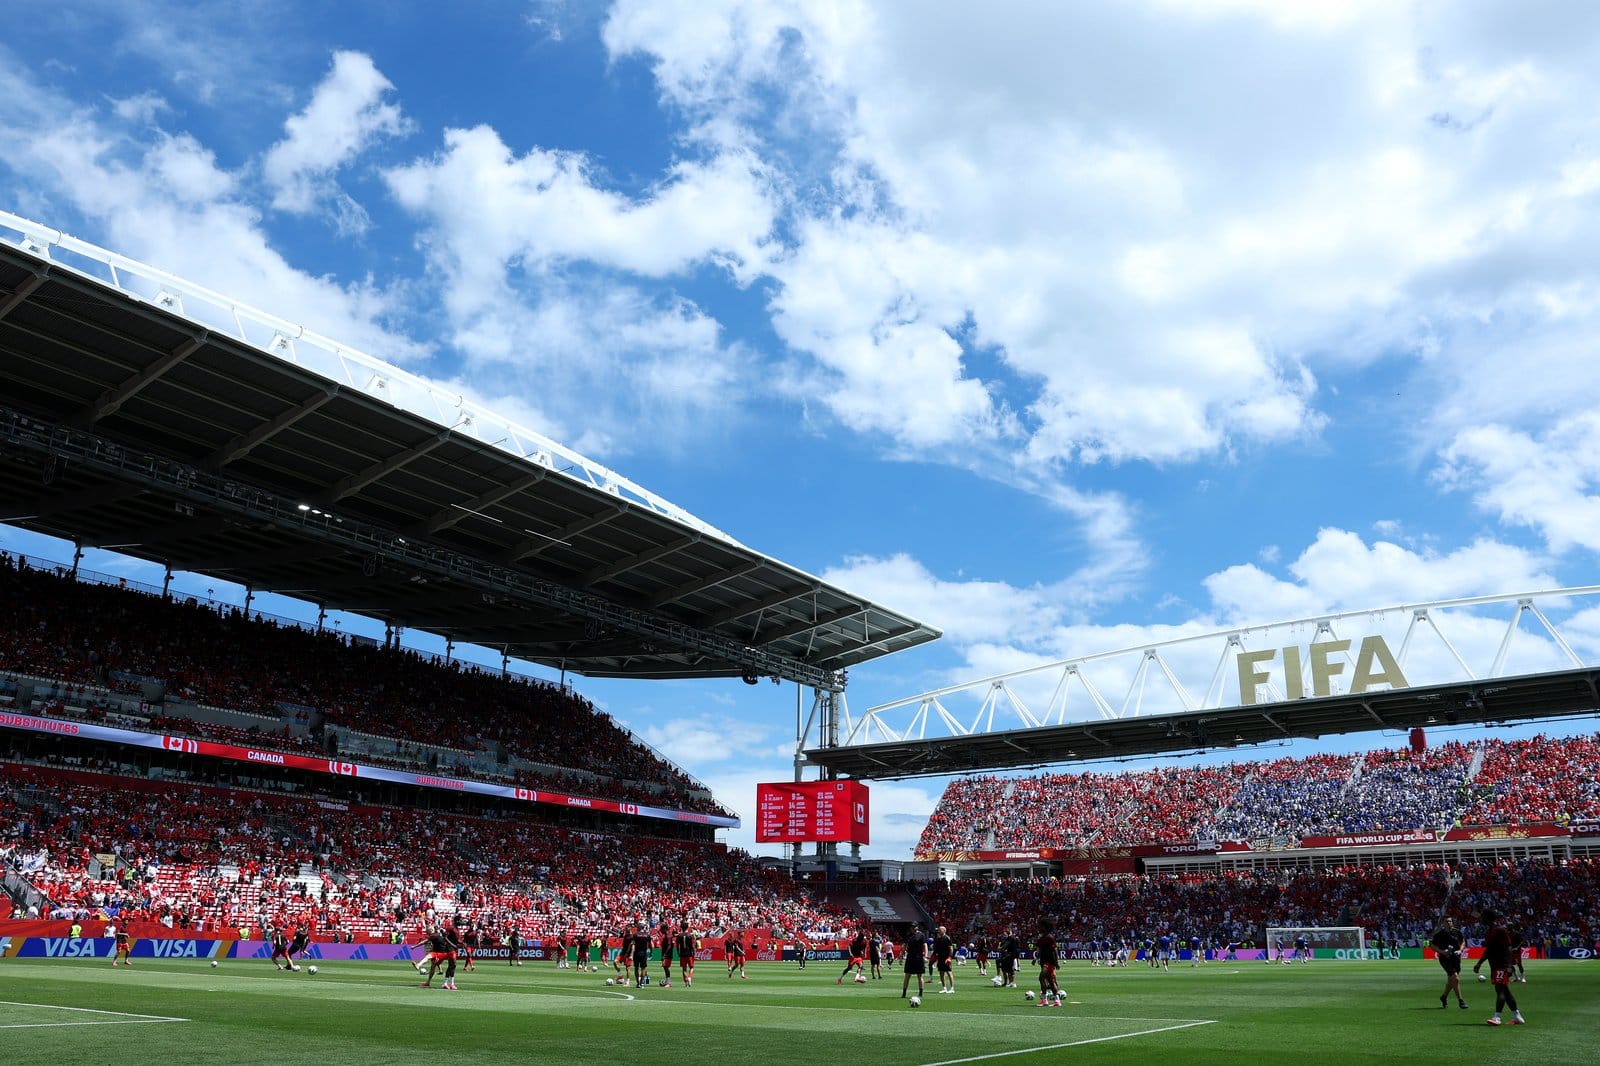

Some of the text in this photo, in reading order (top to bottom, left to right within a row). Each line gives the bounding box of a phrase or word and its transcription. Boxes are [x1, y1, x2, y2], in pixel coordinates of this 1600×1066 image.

[1237, 635, 1410, 705] FIFA
[0, 714, 80, 735] SUBSTITUTES
[247, 750, 285, 764] CANADA
[567, 797, 592, 808] CANADA
[1336, 837, 1353, 845] FIFA
[1354, 835, 1385, 844] WORLD
[1386, 833, 1402, 842] CUP
[1163, 843, 1223, 853] TOROO
[40, 938, 96, 957] VISA
[151, 939, 201, 958] VISA
[500, 949, 510, 957] CU
